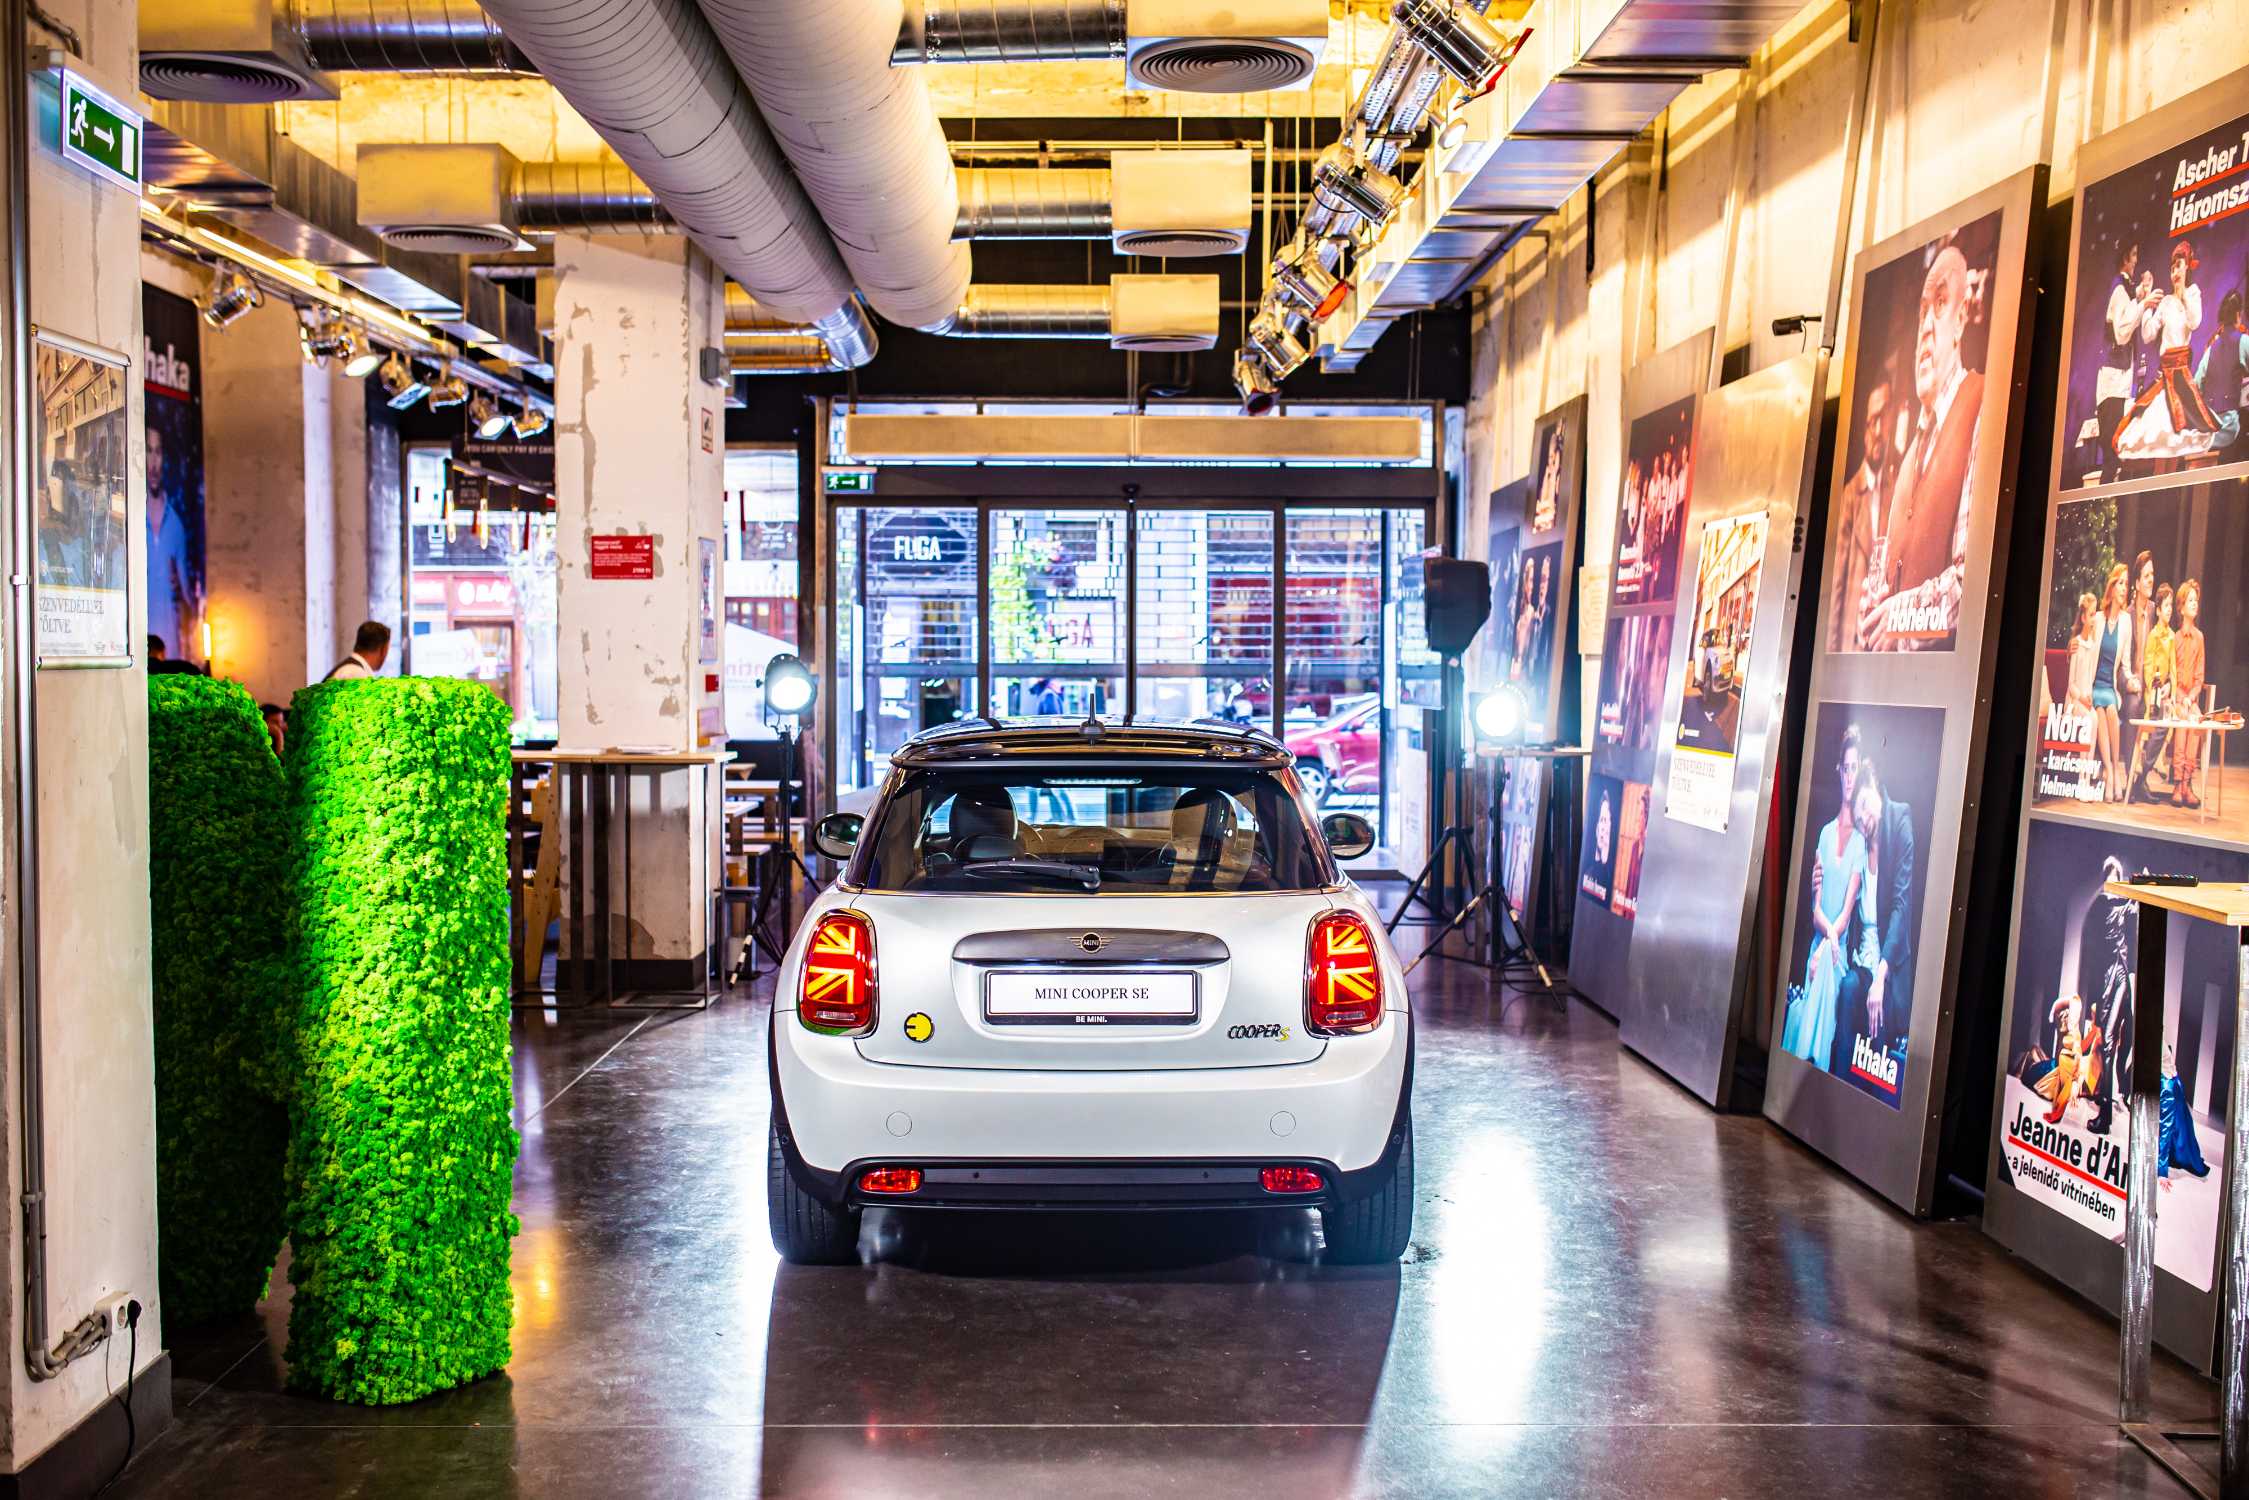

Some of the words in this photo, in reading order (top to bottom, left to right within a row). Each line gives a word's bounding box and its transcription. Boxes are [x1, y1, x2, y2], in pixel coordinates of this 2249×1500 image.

[2172, 145, 2238, 192] Ascher
[894, 535, 941, 561] FUGA
[2044, 702, 2092, 743] Nóra
[1083, 938, 1100, 947] MINI
[1035, 987, 1068, 1000] MINI
[1071, 987, 1129, 1000] COOPER
[1132, 987, 1150, 1000] SE
[1075, 1015, 1086, 1023] BE
[1086, 1015, 1108, 1023] MINI.
[1227, 1023, 1281, 1040] COOPER
[1851, 1032, 1898, 1086] Ithaka
[2010, 1101, 2083, 1167] Jeanne
[2012, 1156, 2019, 1170] a
[2018, 1154, 2060, 1191] jelenidő
[2060, 1178, 2116, 1222] vitrinében
